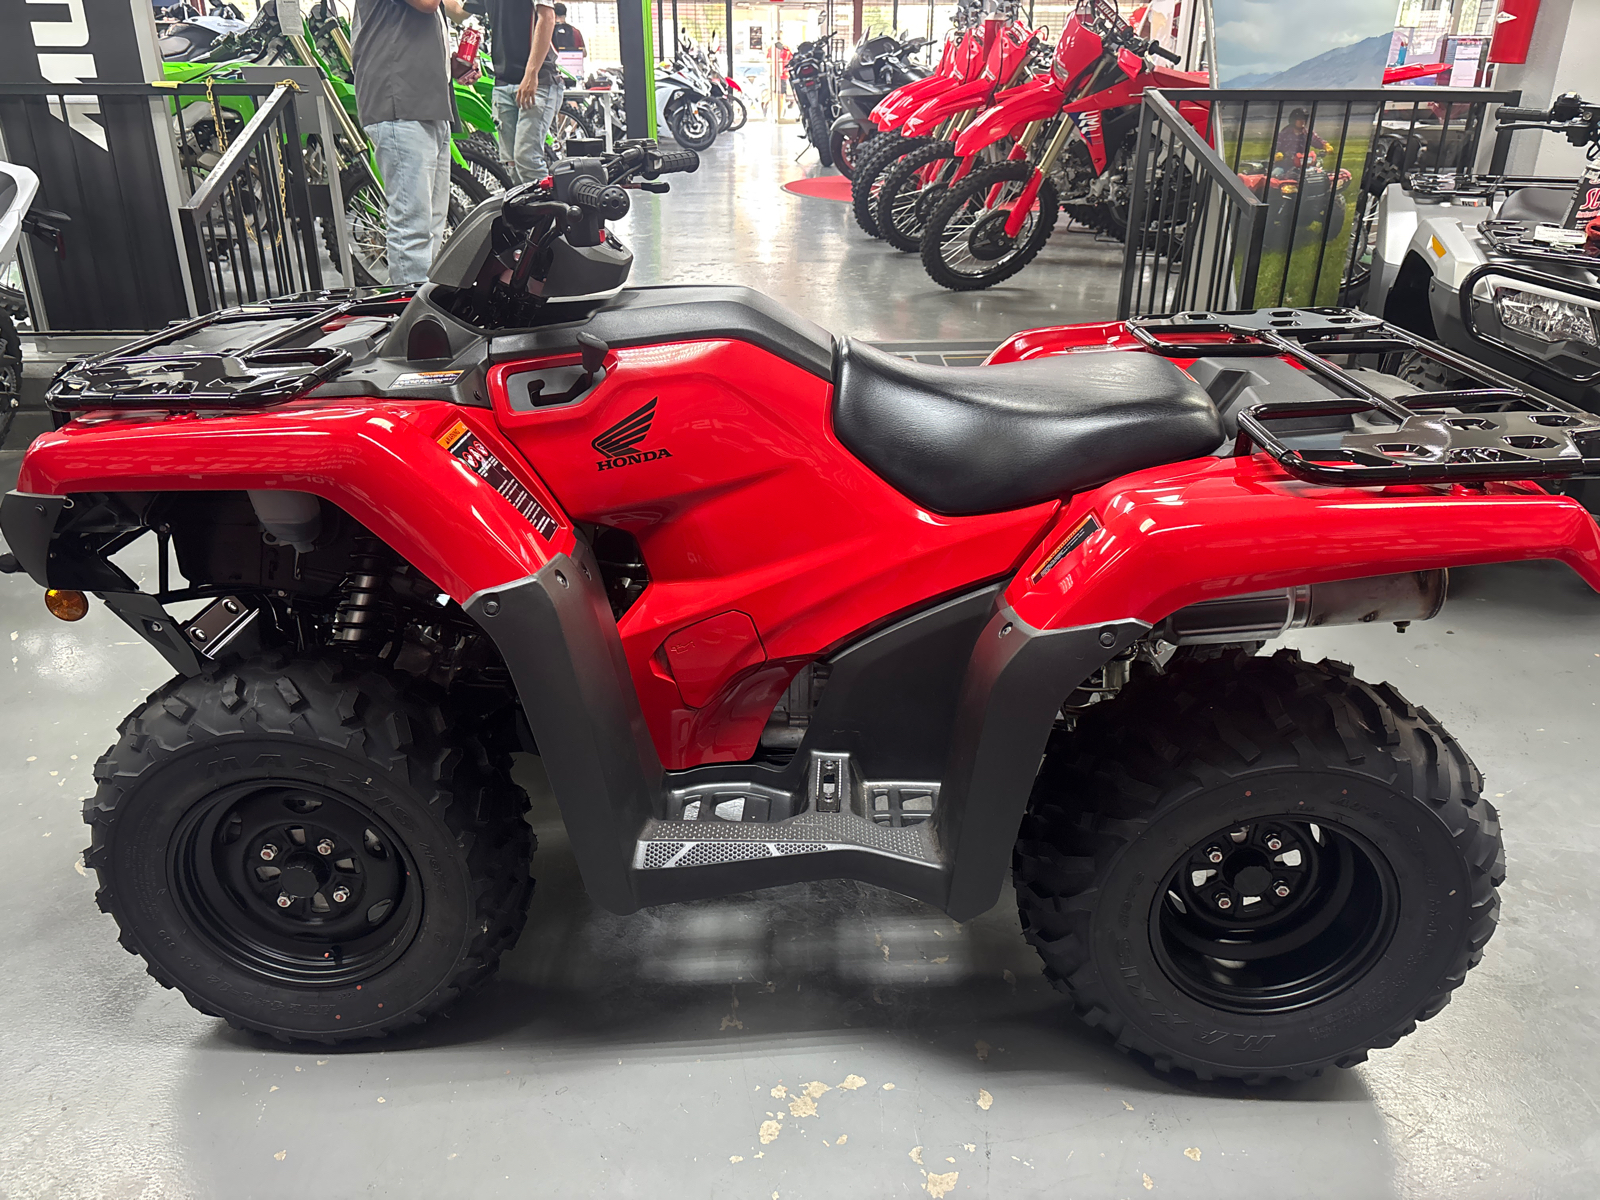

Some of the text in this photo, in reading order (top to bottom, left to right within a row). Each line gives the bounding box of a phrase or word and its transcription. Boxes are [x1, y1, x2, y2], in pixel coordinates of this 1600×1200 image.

[596, 448, 673, 472] HONDA
[204, 752, 419, 833] MAXXIS
[1117, 936, 1277, 1052] MAXXIS
